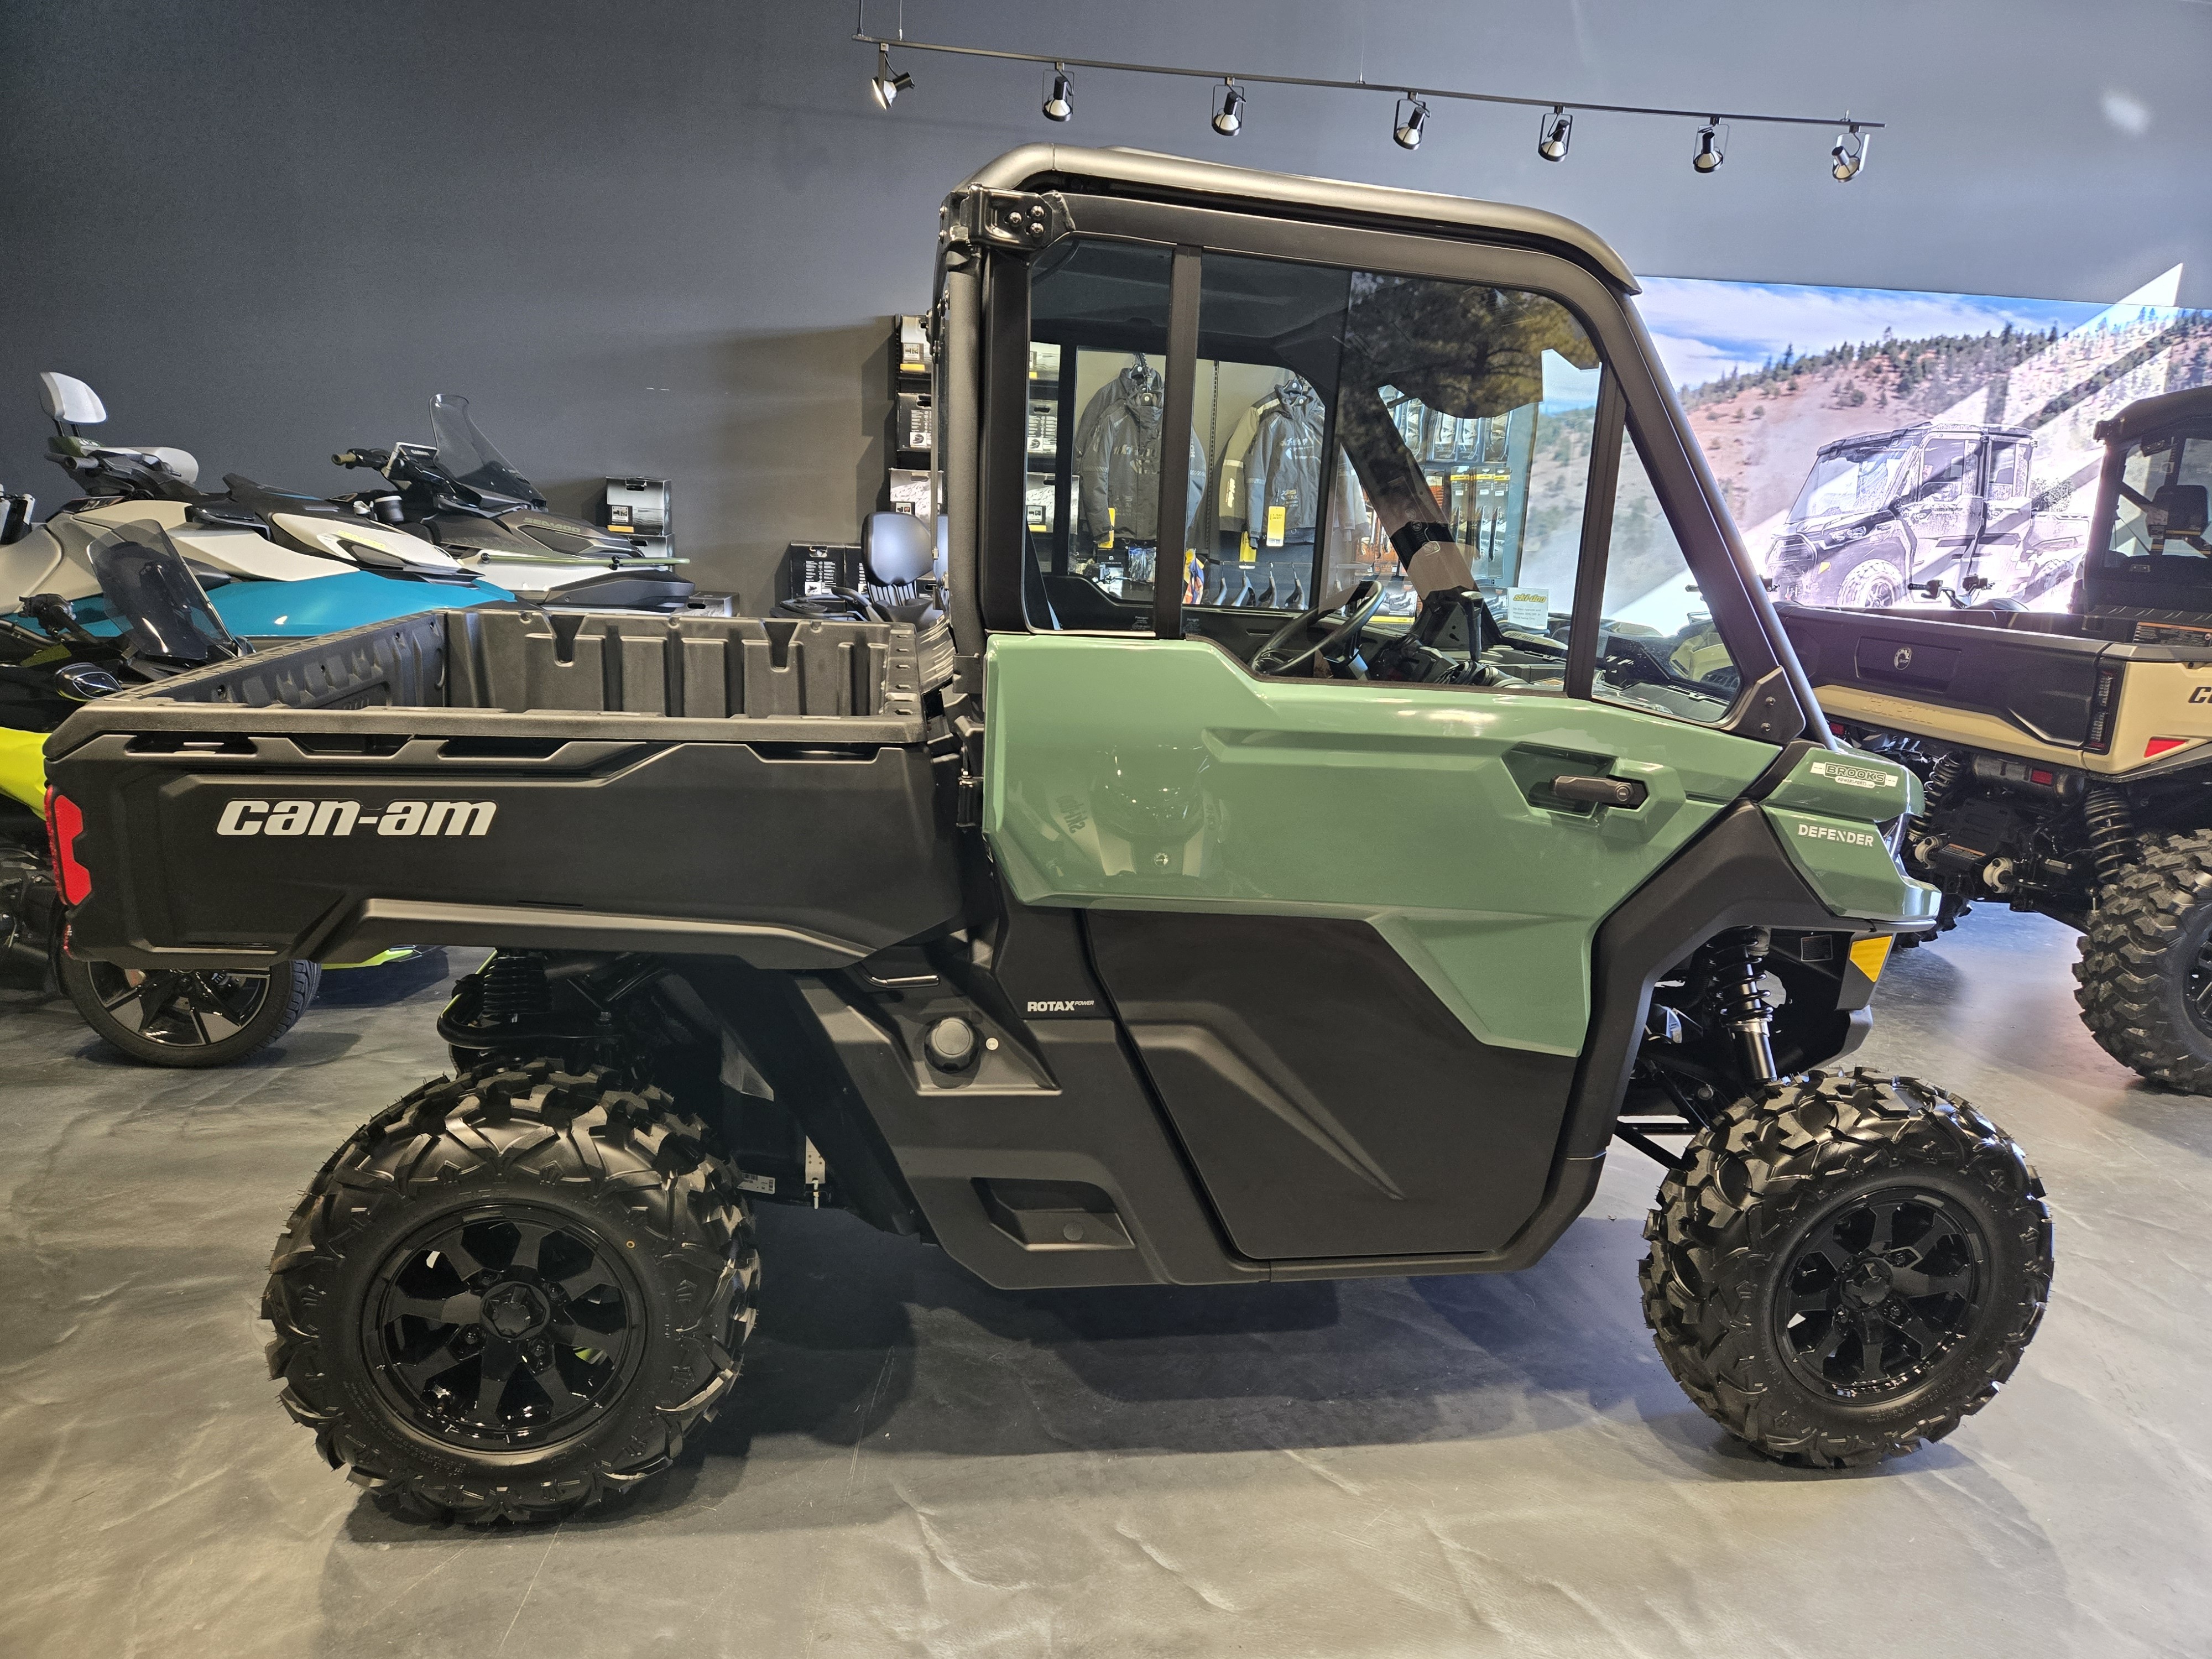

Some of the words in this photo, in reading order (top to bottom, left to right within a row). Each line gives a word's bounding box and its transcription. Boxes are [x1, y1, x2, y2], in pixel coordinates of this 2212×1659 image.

[1512, 593, 1547, 603] ski-doo
[1825, 764, 1885, 782] BROOKS
[216, 800, 497, 836] can-am
[1798, 823, 1874, 847] DEFENDER
[1027, 1000, 1075, 1012] ROTAX
